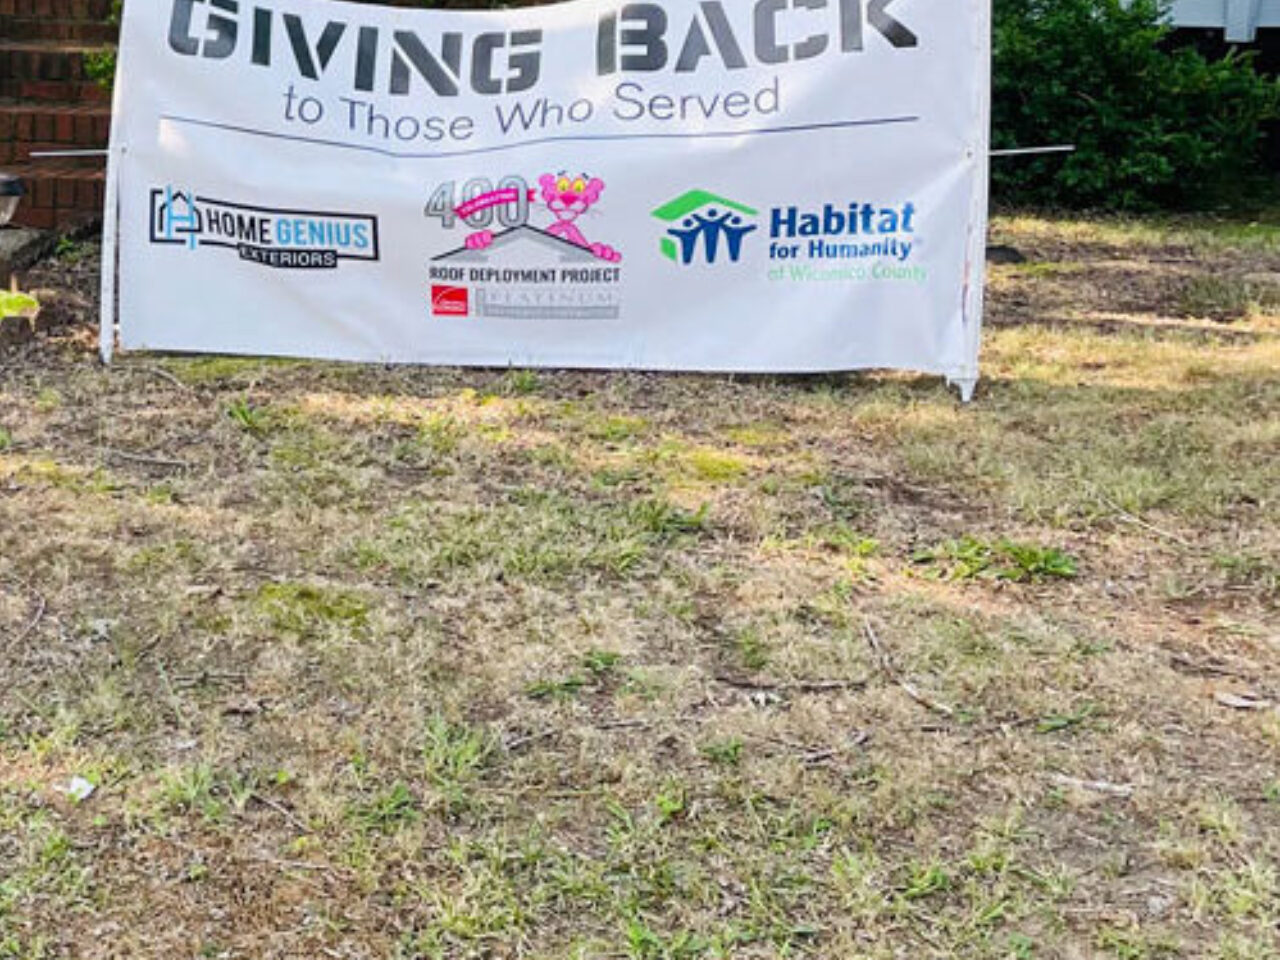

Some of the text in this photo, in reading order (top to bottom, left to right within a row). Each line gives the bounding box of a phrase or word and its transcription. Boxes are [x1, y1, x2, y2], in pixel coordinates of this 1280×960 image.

[283, 76, 780, 140] to Those Who Served
[424, 175, 529, 229] 400
[770, 202, 915, 238] Habitat
[206, 208, 368, 248] HOME GENIUS
[239, 244, 336, 267] EXTERIORS
[769, 237, 912, 261] for Humanity
[429, 267, 621, 283] ROOF DEPLOYMENT PROJECT
